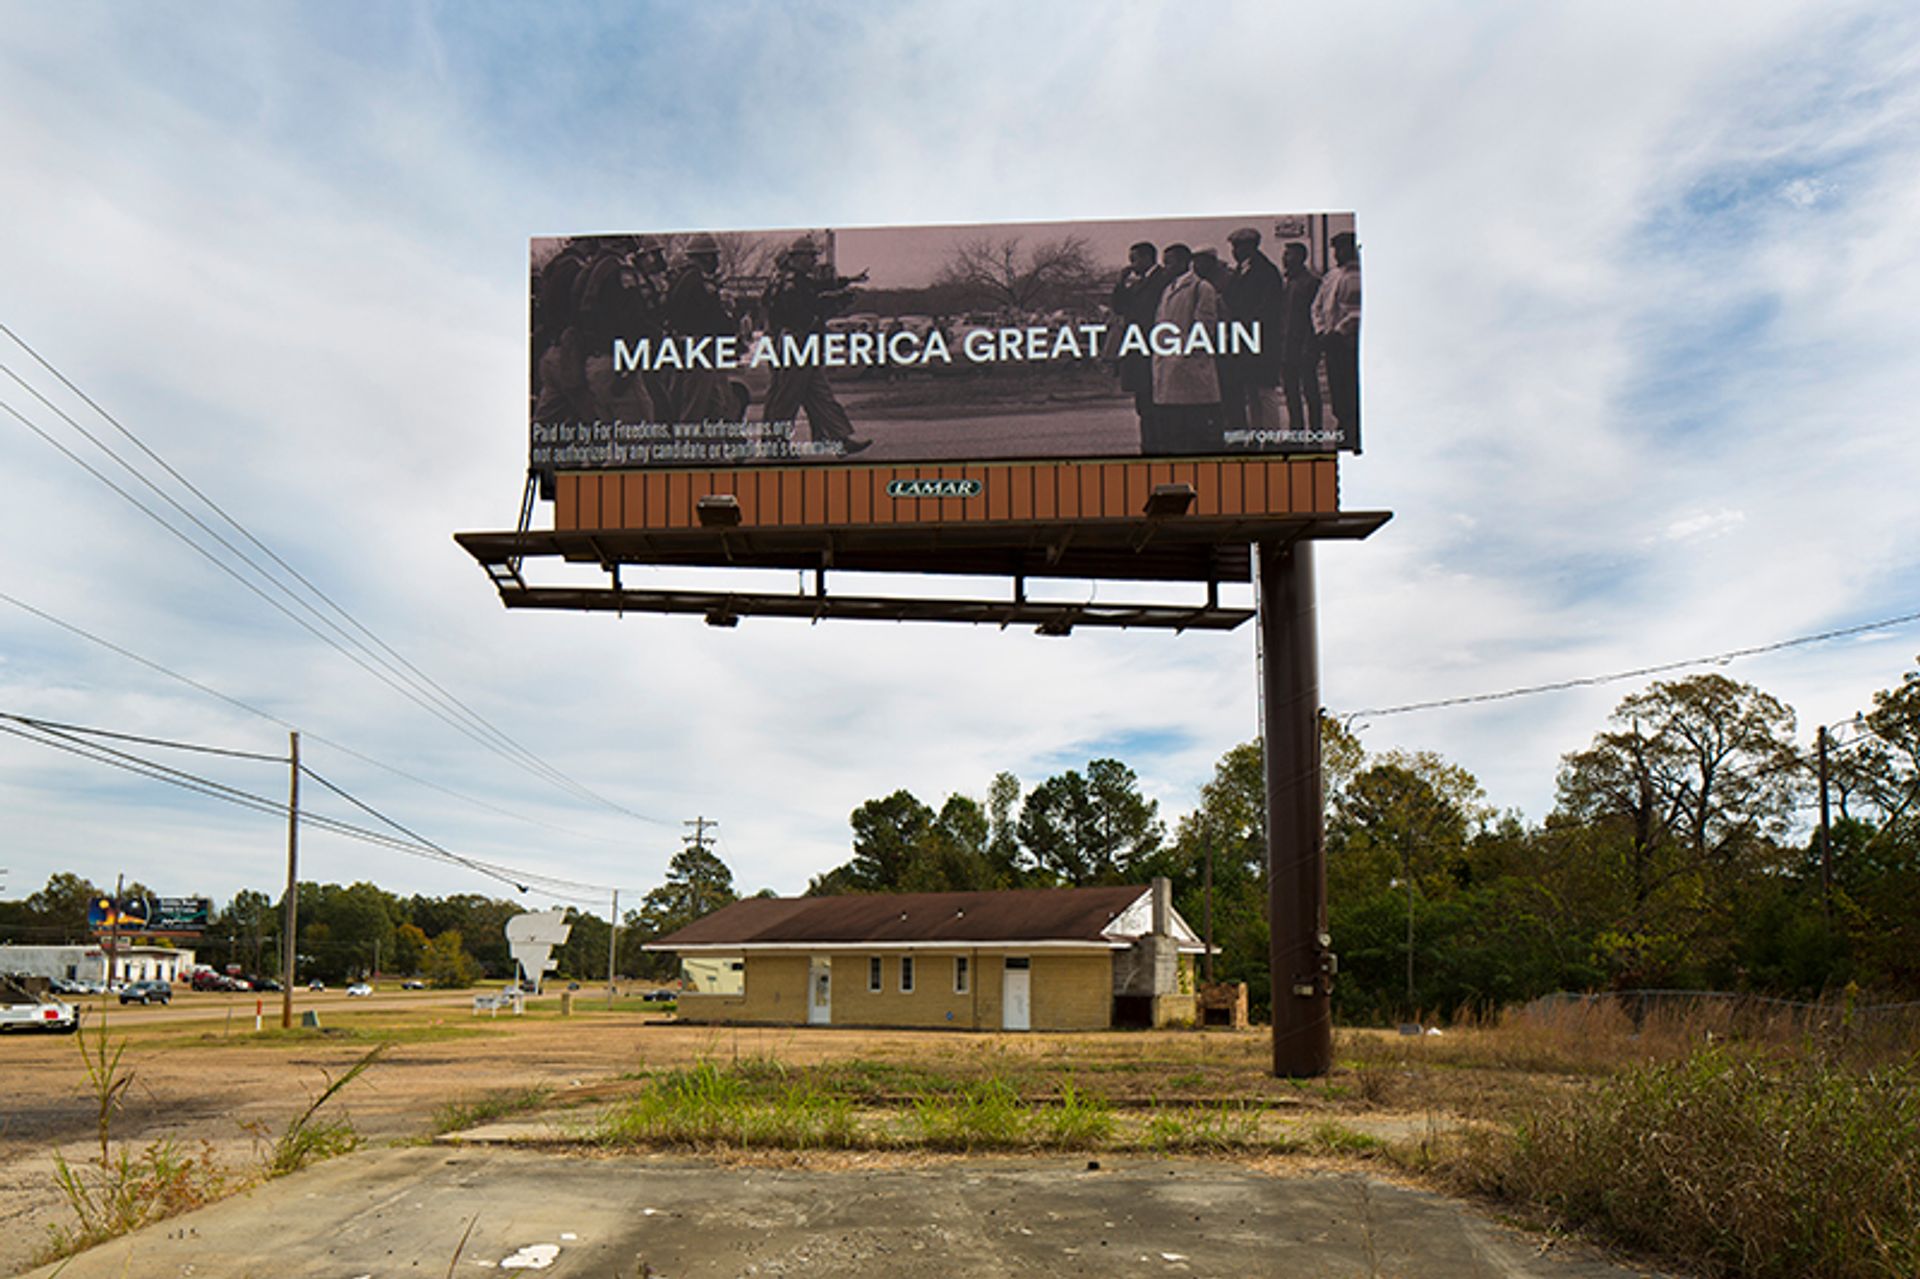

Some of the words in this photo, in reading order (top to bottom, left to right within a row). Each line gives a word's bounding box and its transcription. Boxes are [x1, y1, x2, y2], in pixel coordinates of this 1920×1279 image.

[613, 335, 737, 371] MAKE
[750, 329, 952, 369] AMERICA
[964, 323, 1107, 362] GREAT
[1118, 320, 1262, 357] AGAIN
[533, 422, 557, 442] Paid
[559, 421, 575, 441] for
[578, 421, 592, 444] by
[593, 419, 610, 440] For
[614, 441, 628, 463] by
[629, 444, 650, 463] any
[652, 440, 707, 460] candidate
[708, 443, 721, 459] or
[895, 481, 973, 496] LAMAR
